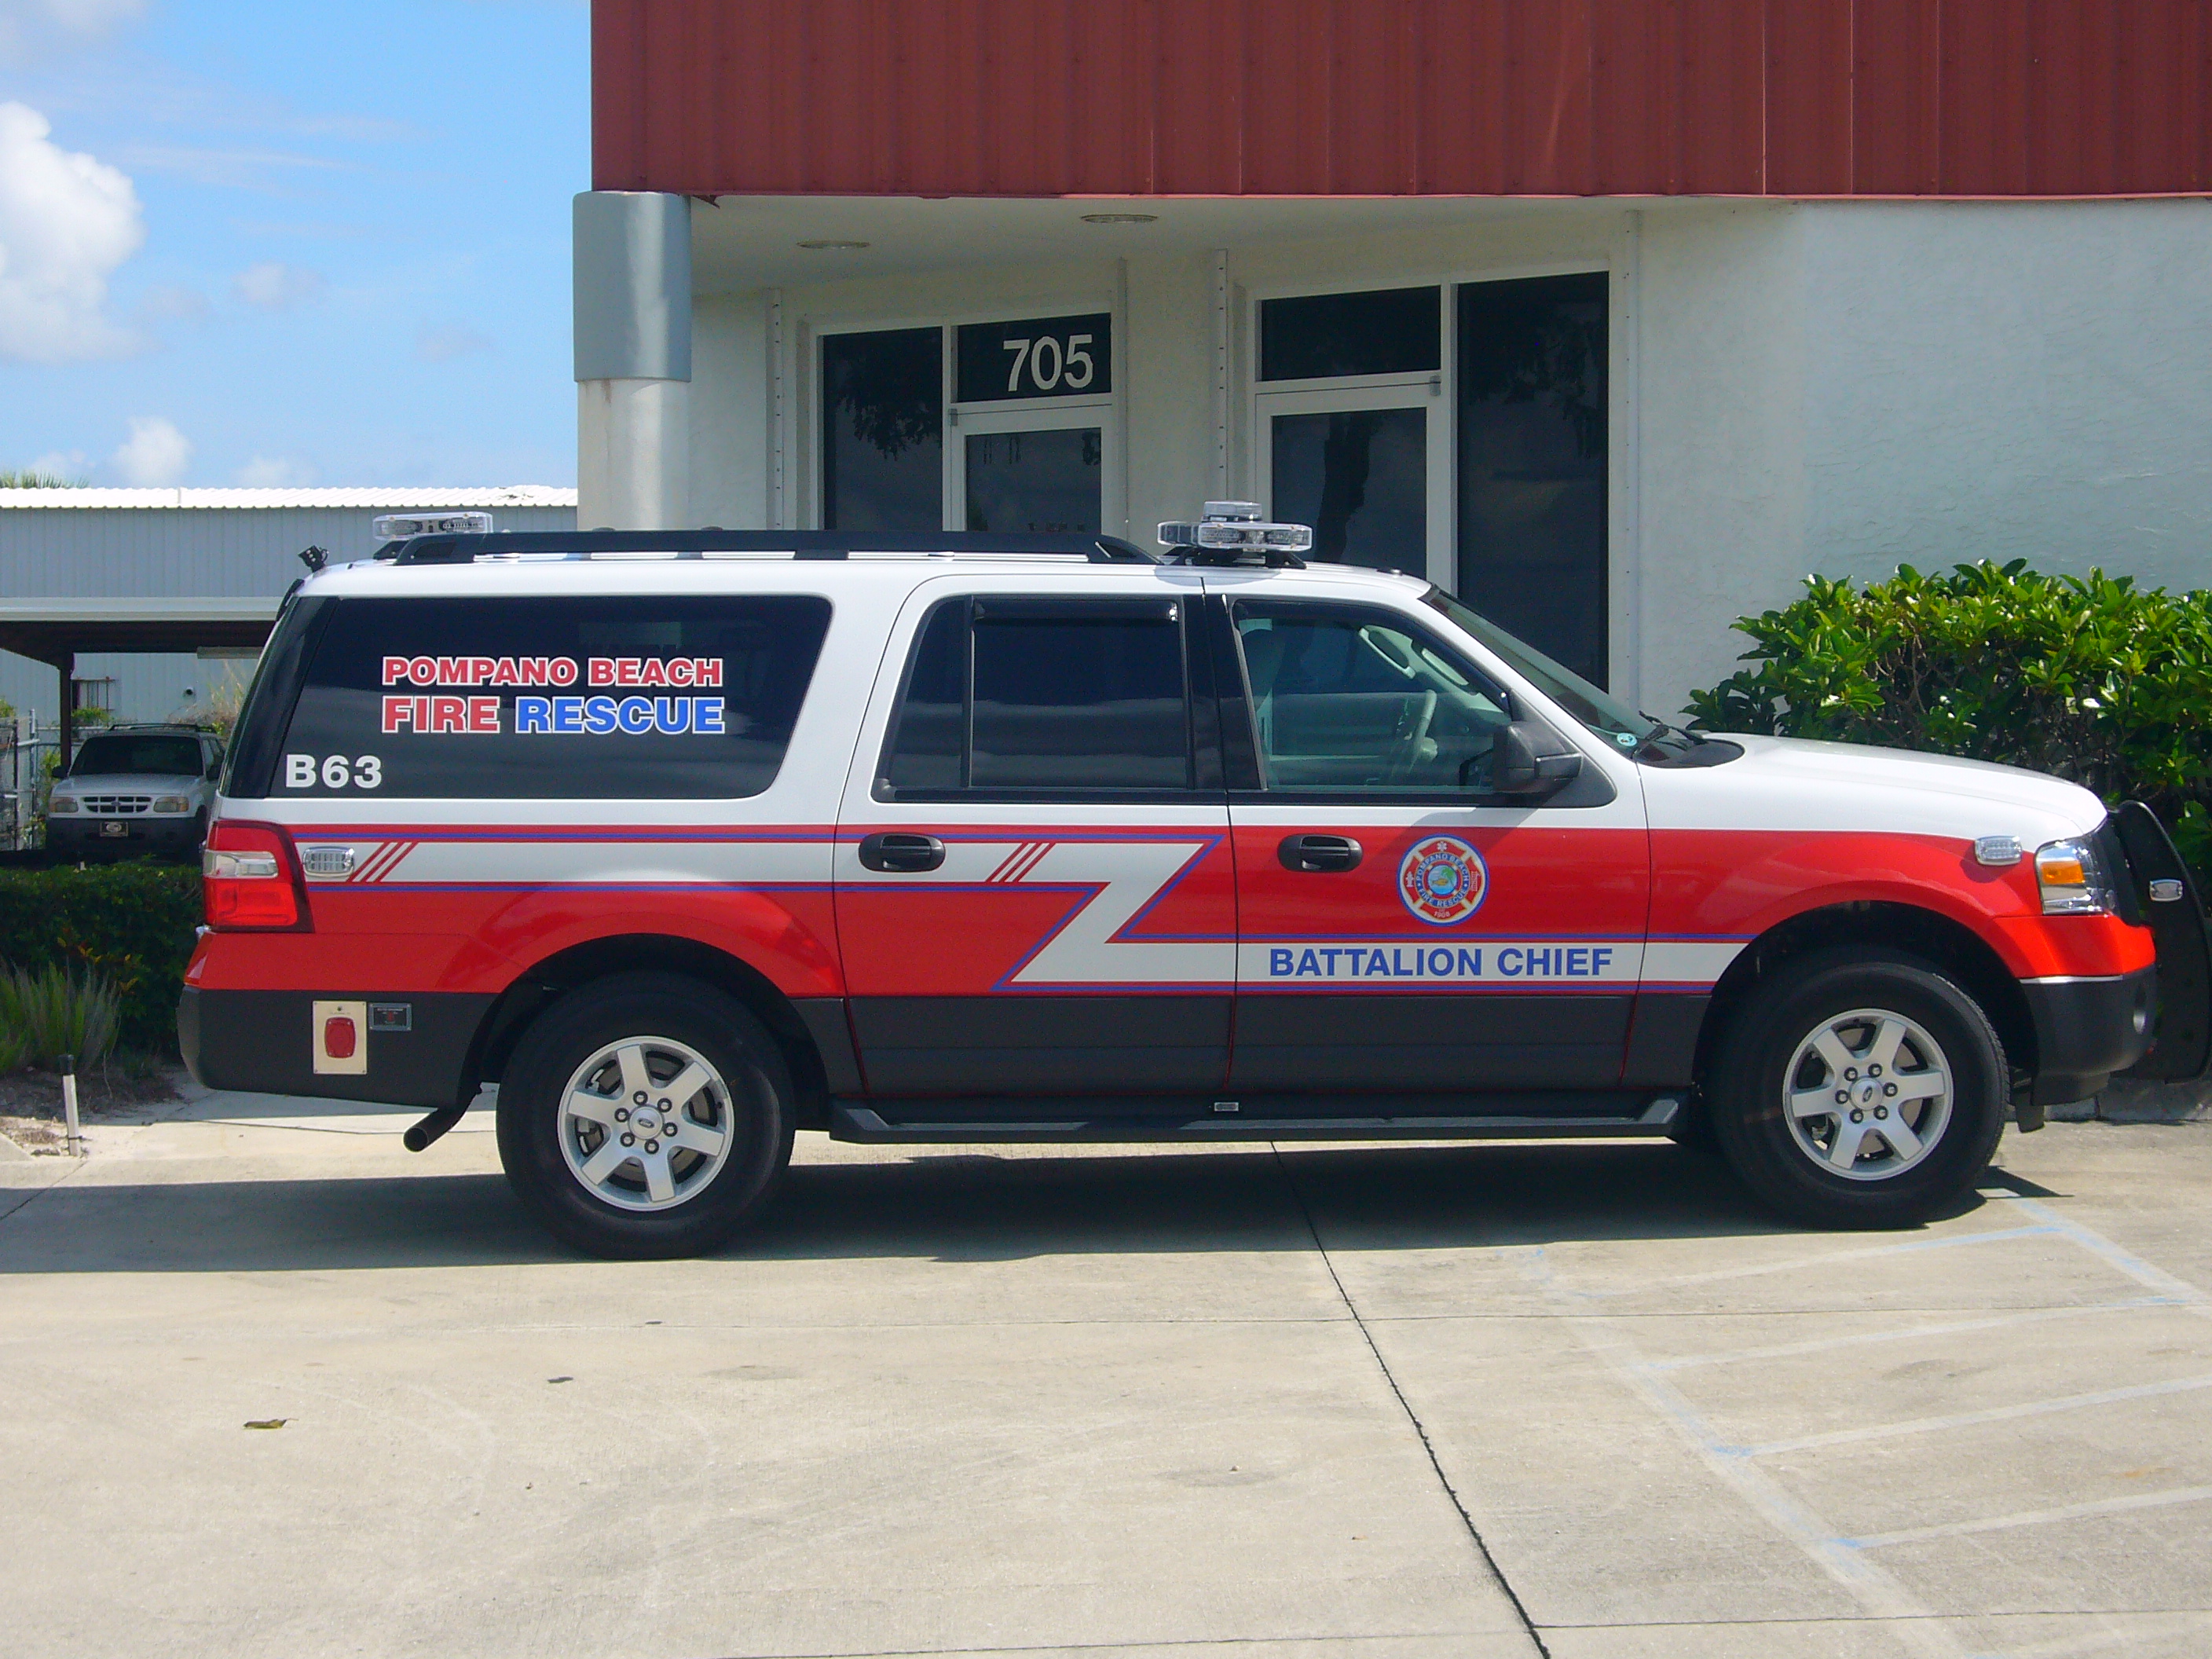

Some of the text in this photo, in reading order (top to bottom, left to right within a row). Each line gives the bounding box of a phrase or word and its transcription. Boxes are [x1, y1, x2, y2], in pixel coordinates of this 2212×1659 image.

[1002, 334, 1093, 392] 705
[382, 656, 723, 687] POMPANO BEACH
[382, 696, 725, 734] FIRE RESCUE
[286, 754, 383, 789] B63
[1415, 852, 1470, 881] POMPANO BEACH
[1418, 888, 1467, 907] FIRE RESCUE
[1269, 947, 1613, 977] BATTALION CHIEF
